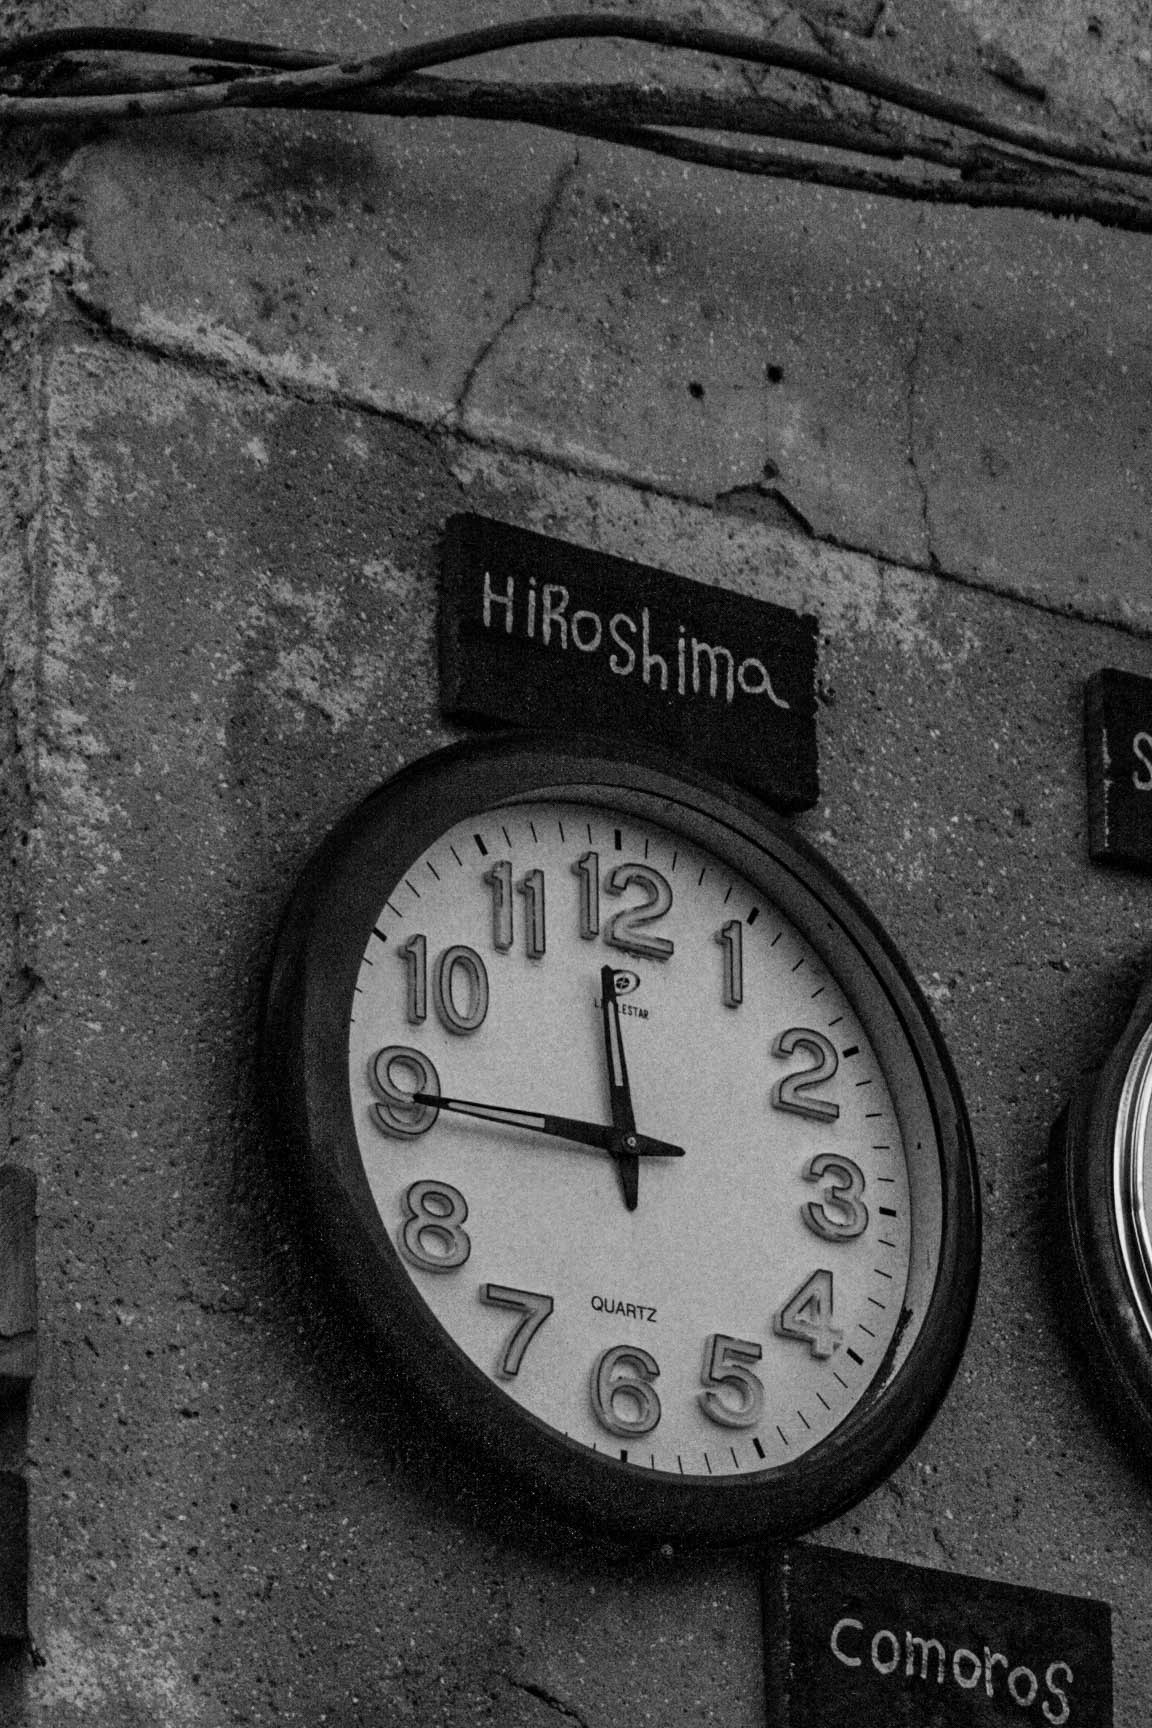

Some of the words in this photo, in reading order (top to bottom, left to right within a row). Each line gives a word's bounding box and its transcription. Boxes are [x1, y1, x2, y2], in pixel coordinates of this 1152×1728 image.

[482, 860, 546, 960] 11
[573, 851, 675, 961] 12
[398, 934, 490, 1034] 10
[714, 919, 744, 1009] 1
[368, 1044, 441, 1138] 9
[771, 1027, 841, 1123] 2
[399, 1179, 473, 1273] 8
[800, 1152, 870, 1243] 3
[479, 1283, 555, 1378] 7
[589, 1295, 658, 1324] QUARTZ
[773, 1268, 843, 1361] 4
[590, 1344, 662, 1438] 6
[699, 1332, 766, 1429] 5
